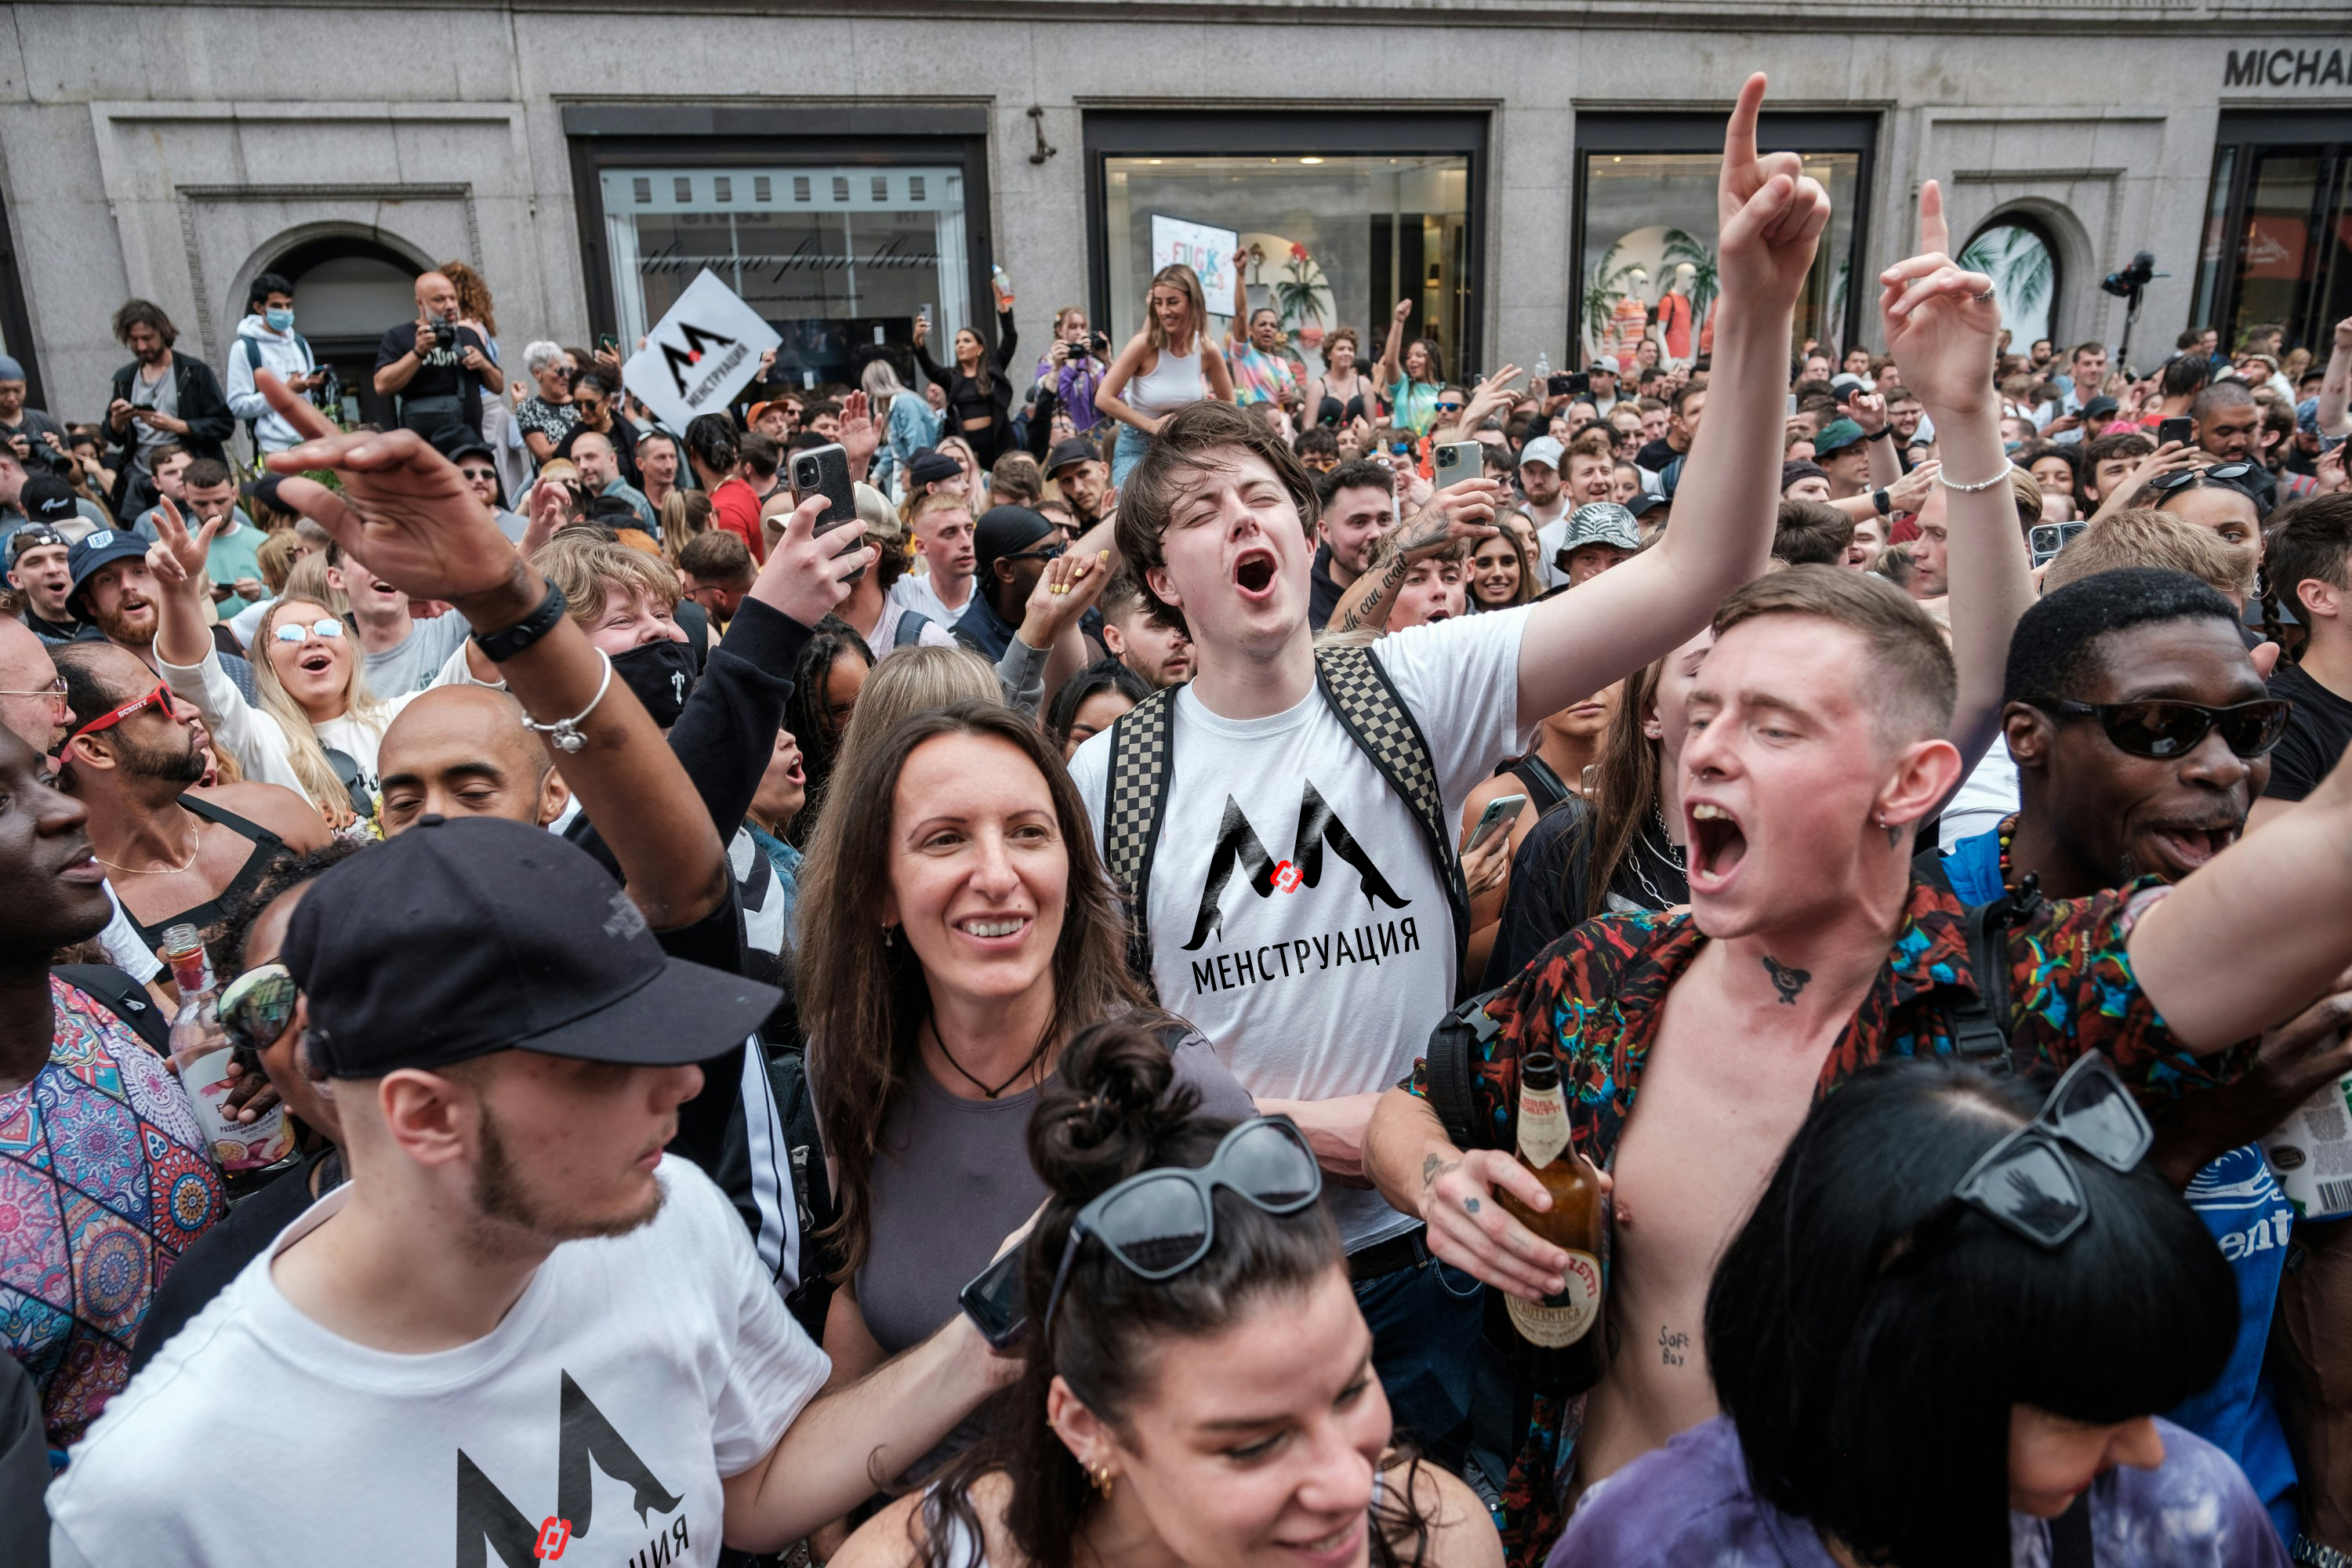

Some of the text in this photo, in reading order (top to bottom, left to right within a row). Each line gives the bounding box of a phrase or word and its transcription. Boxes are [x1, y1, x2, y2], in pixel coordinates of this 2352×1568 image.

[2223, 49, 2352, 86] MICHA
[640, 234, 941, 284] the view from there
[1172, 241, 1219, 273] FUCK
[685, 342, 750, 411] МЕНСТРУАЦИЯ
[1359, 587, 1382, 615] can
[1381, 551, 1410, 589] wait
[1192, 916, 1421, 995] МЕНСТРУАЦИЯ
[1569, 1257, 1597, 1298] RETTI
